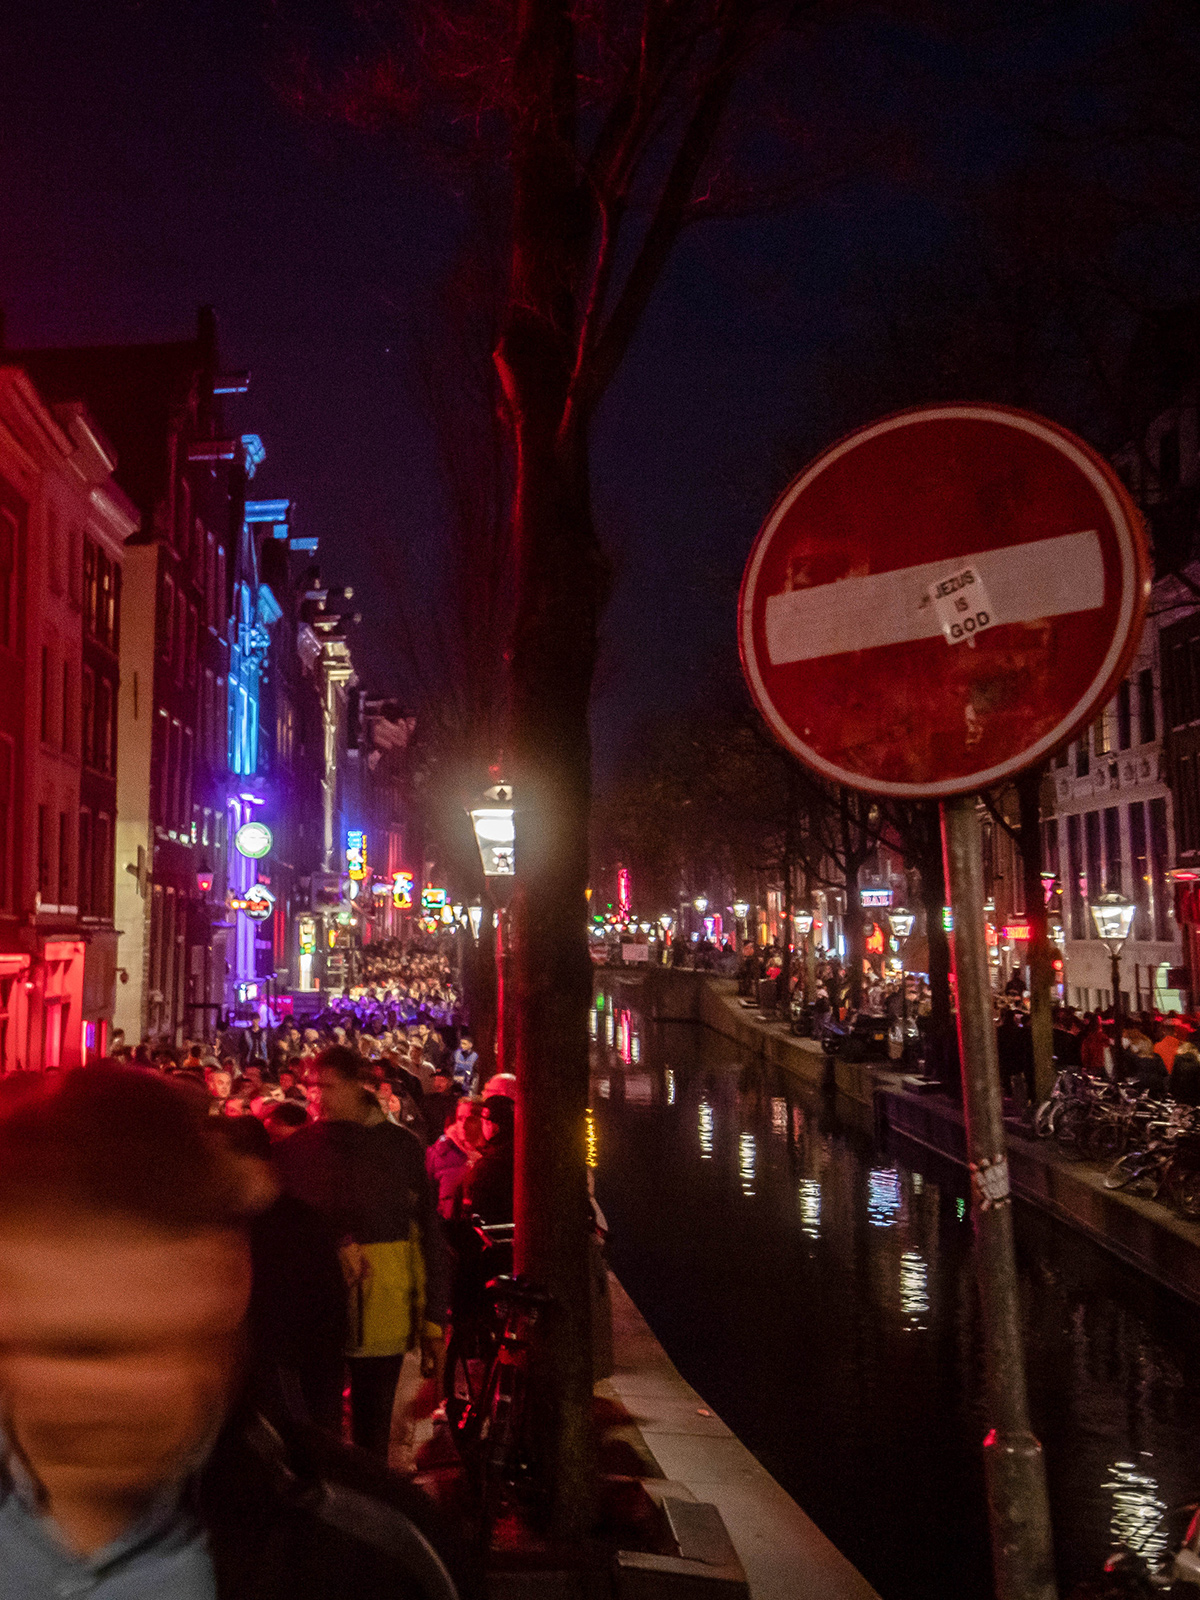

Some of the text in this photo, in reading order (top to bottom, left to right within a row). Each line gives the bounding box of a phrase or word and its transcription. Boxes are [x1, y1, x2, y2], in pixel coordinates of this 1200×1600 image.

[935, 570, 975, 599] JEZUS
[954, 596, 969, 612] IS
[950, 611, 990, 639] GOD
